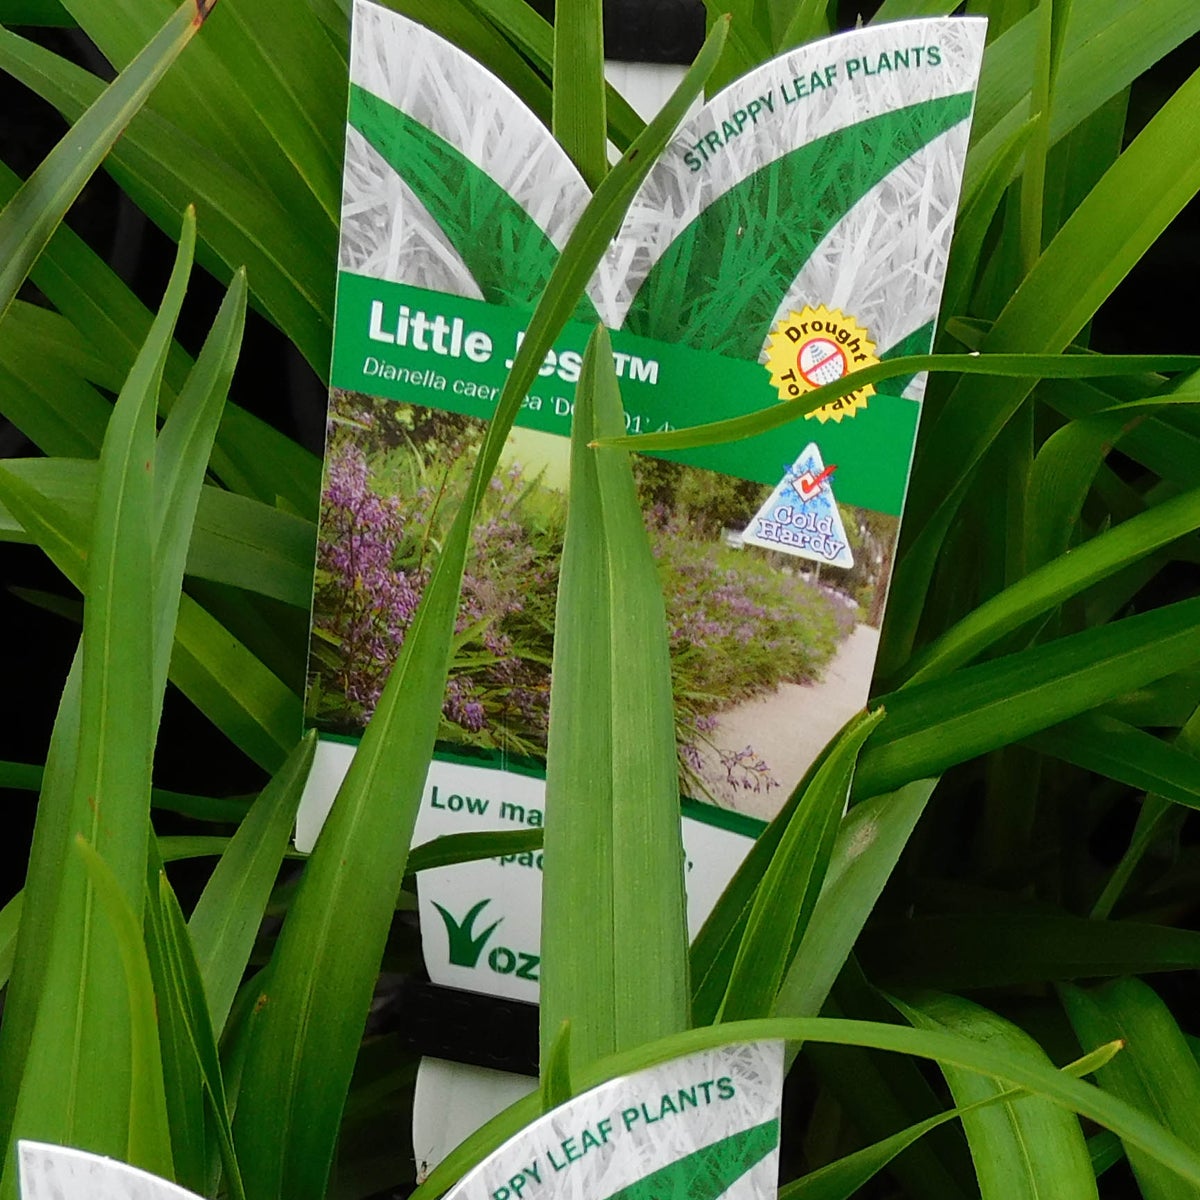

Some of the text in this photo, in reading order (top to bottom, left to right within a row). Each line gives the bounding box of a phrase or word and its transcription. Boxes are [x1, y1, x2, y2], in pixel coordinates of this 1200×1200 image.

[683, 45, 942, 172] STRAPPY LEAF PLANTS
[368, 300, 493, 363] Little
[785, 321, 868, 362] Drought
[363, 357, 542, 411] Dianella caerea
[756, 517, 845, 560] Hardy
[773, 505, 835, 537] Cold
[430, 785, 489, 816] Low
[546, 1119, 613, 1172] LEAF
[622, 1076, 736, 1132] PLANTS
